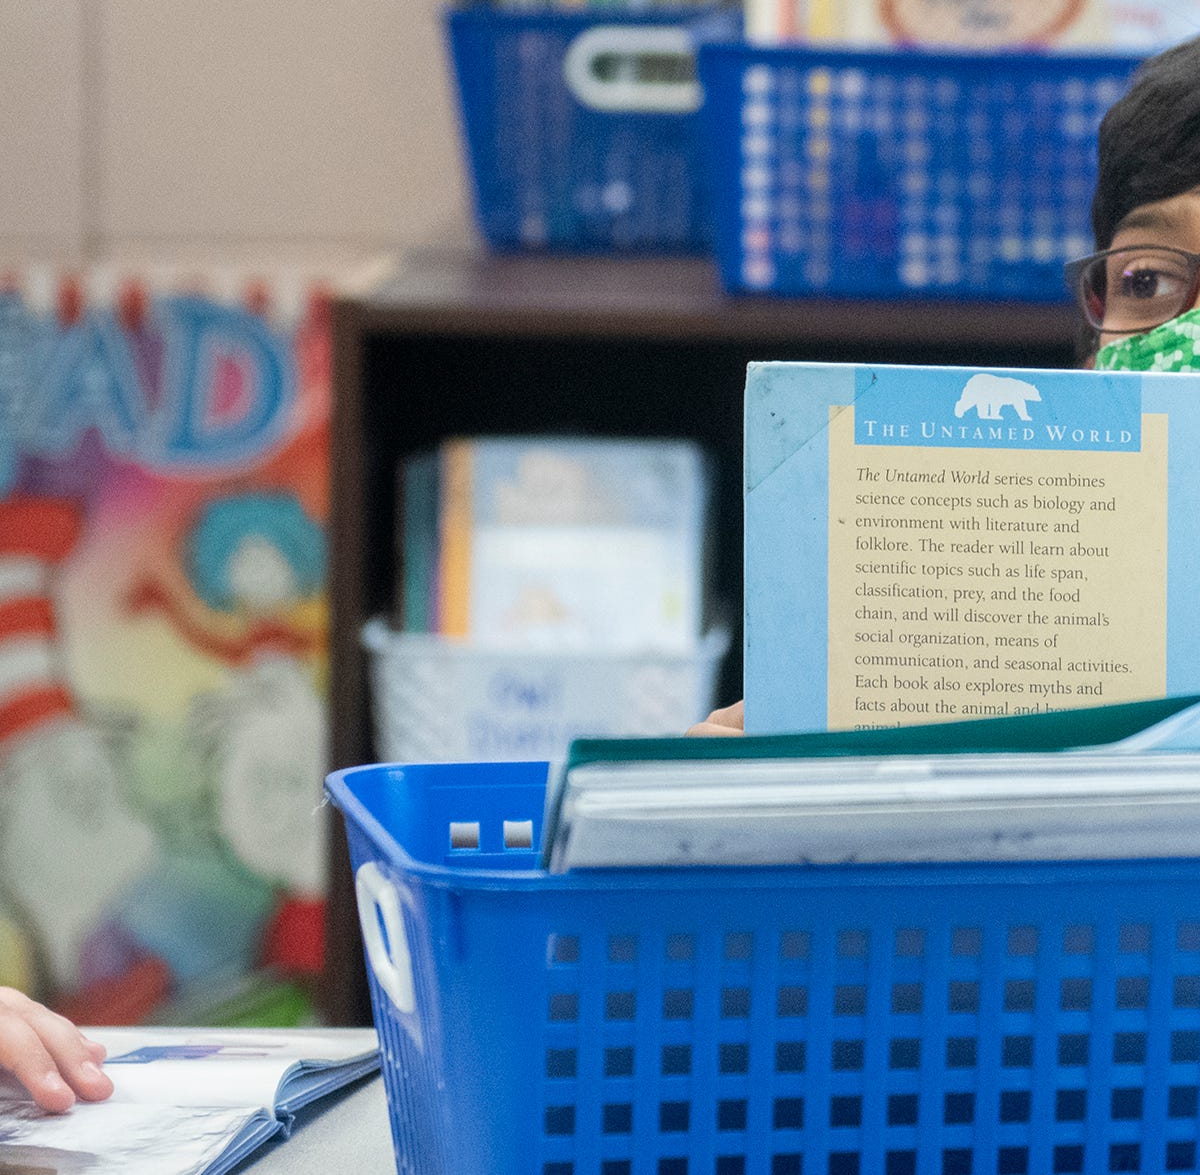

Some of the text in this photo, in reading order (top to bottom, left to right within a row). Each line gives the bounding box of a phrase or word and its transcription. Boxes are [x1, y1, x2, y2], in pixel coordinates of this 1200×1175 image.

[0, 290, 302, 470] AD
[864, 421, 1132, 443] THE UNTAMED WORLD
[856, 466, 1106, 488] The Untamed World series combines
[855, 491, 1116, 515] science concepts such as biology and
[855, 515, 1080, 534] environment with literature and
[855, 536, 1109, 558] folklore. The reader will learn about
[855, 560, 1088, 584] scientific topics such as life span,
[854, 582, 1081, 604] classification, prey, and the food
[854, 605, 1110, 627] chain, and will discover the animal's
[854, 628, 1058, 648] social organization, means of
[854, 654, 1133, 673] communication, and seasonal activities.
[855, 674, 1103, 698] Each book also explores myths and
[855, 696, 886, 712] facts
[890, 697, 929, 713] about
[935, 699, 957, 714] the
[961, 701, 1010, 716] animal
[1013, 702, 1040, 715] and
